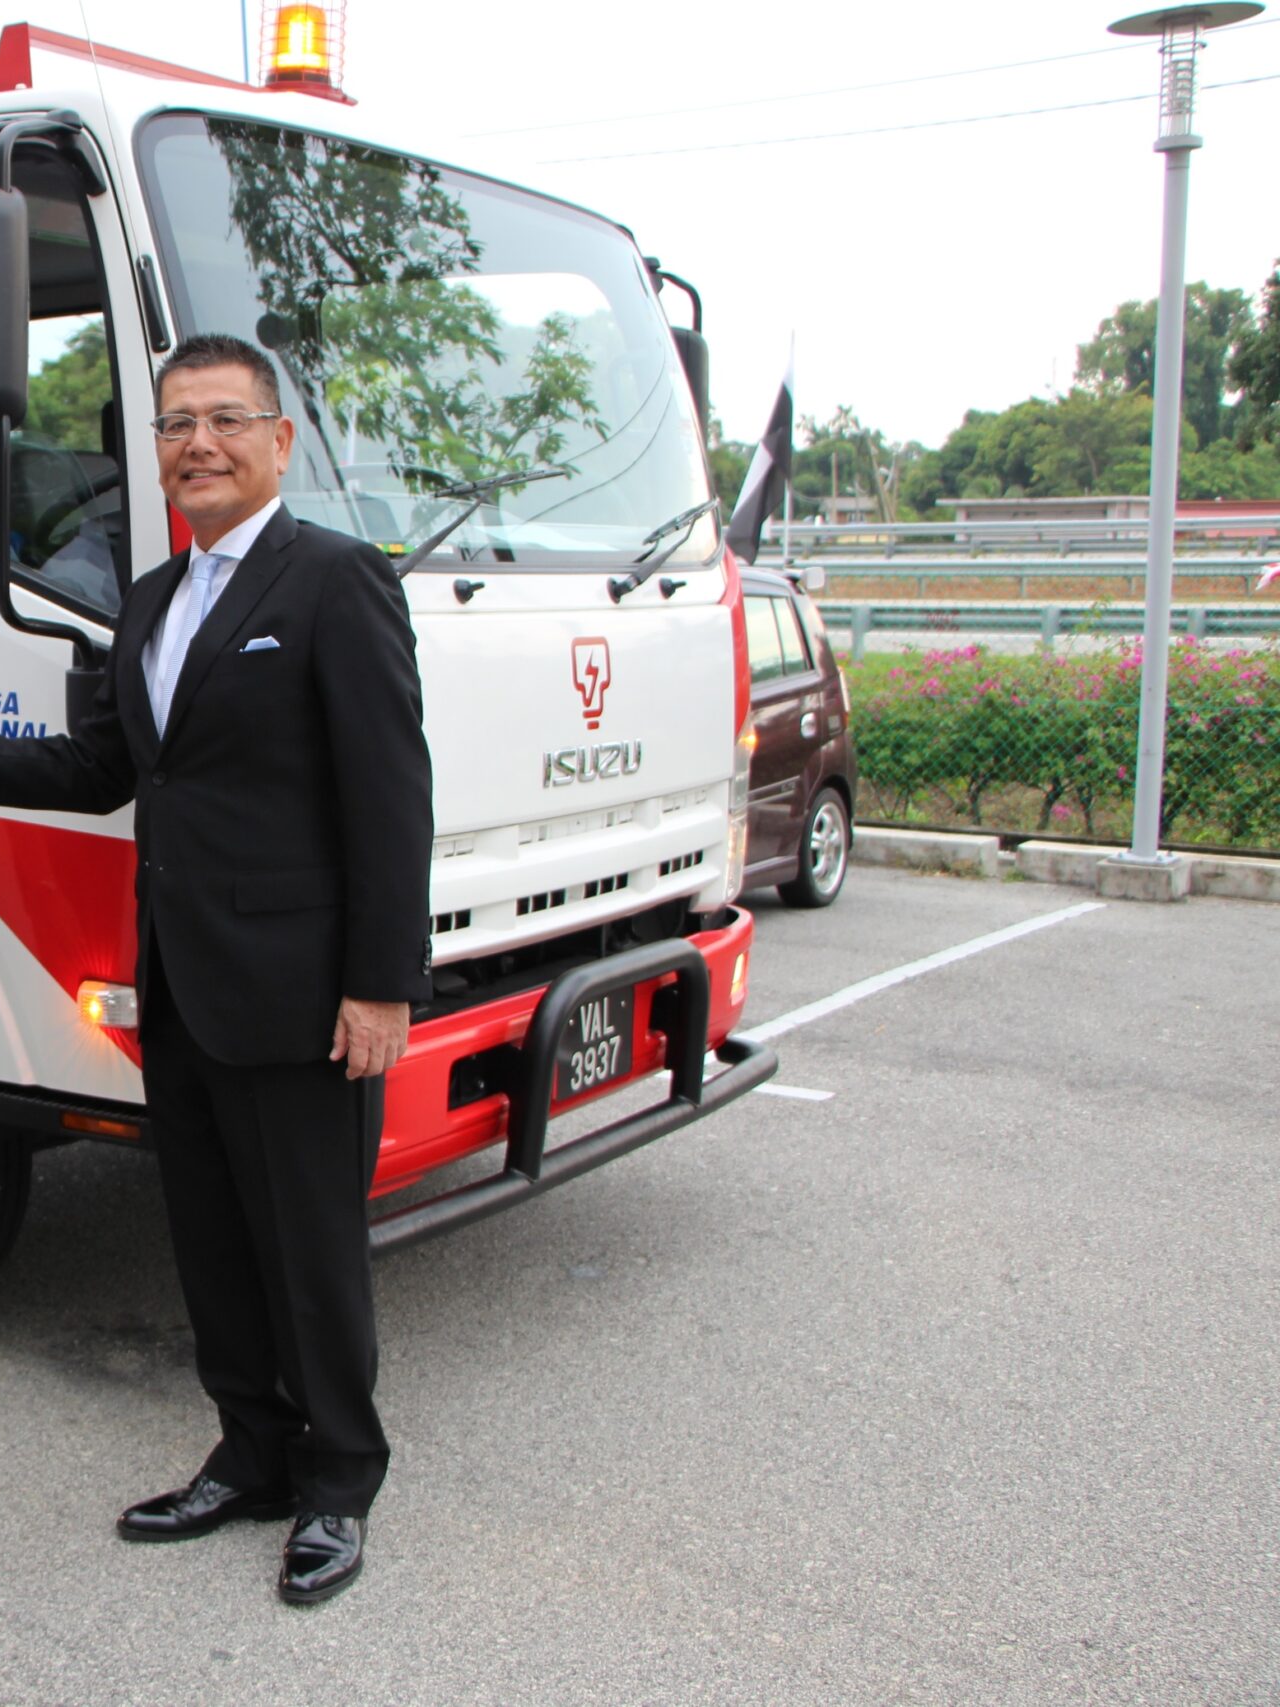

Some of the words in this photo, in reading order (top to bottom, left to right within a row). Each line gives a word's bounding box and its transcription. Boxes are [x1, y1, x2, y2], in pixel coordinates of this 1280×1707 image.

[542, 738, 642, 789] ISUZU
[580, 996, 615, 1043] VAL
[570, 1035, 621, 1091] 3937
